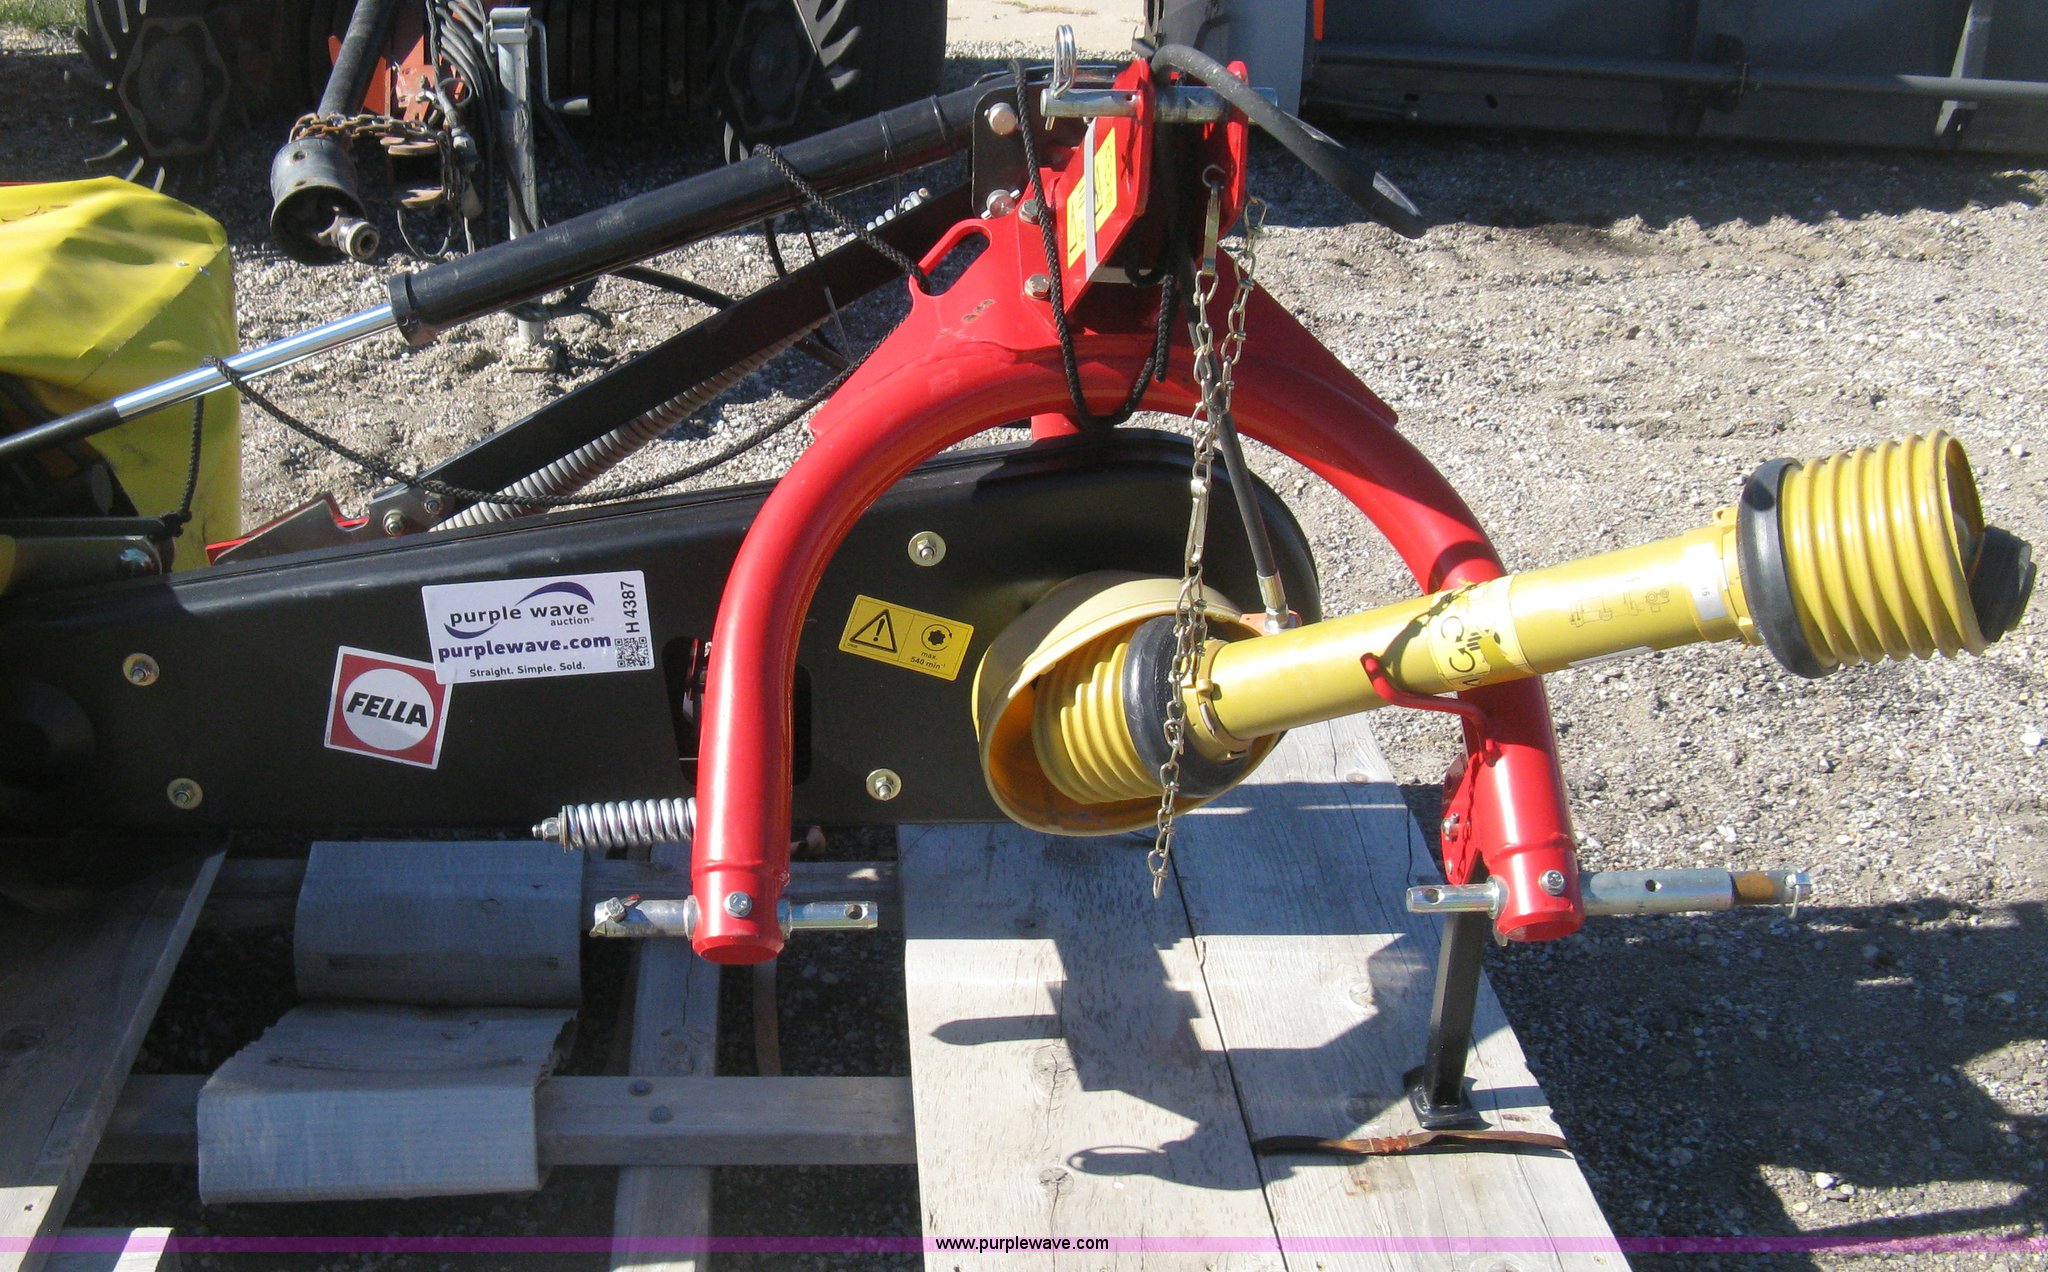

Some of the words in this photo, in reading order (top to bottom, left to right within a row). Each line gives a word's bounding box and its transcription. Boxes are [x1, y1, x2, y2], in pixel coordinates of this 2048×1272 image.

[620, 581, 639, 618] 4387
[450, 606, 522, 627] purple
[530, 602, 589, 618] wave
[625, 622, 641, 633] H
[438, 635, 612, 663] purplewave.com
[911, 656, 925, 665] 540
[469, 665, 515, 680] Straight.
[517, 663, 557, 675] Simple.
[559, 662, 586, 672] Sold.
[346, 691, 428, 728] FELLA
